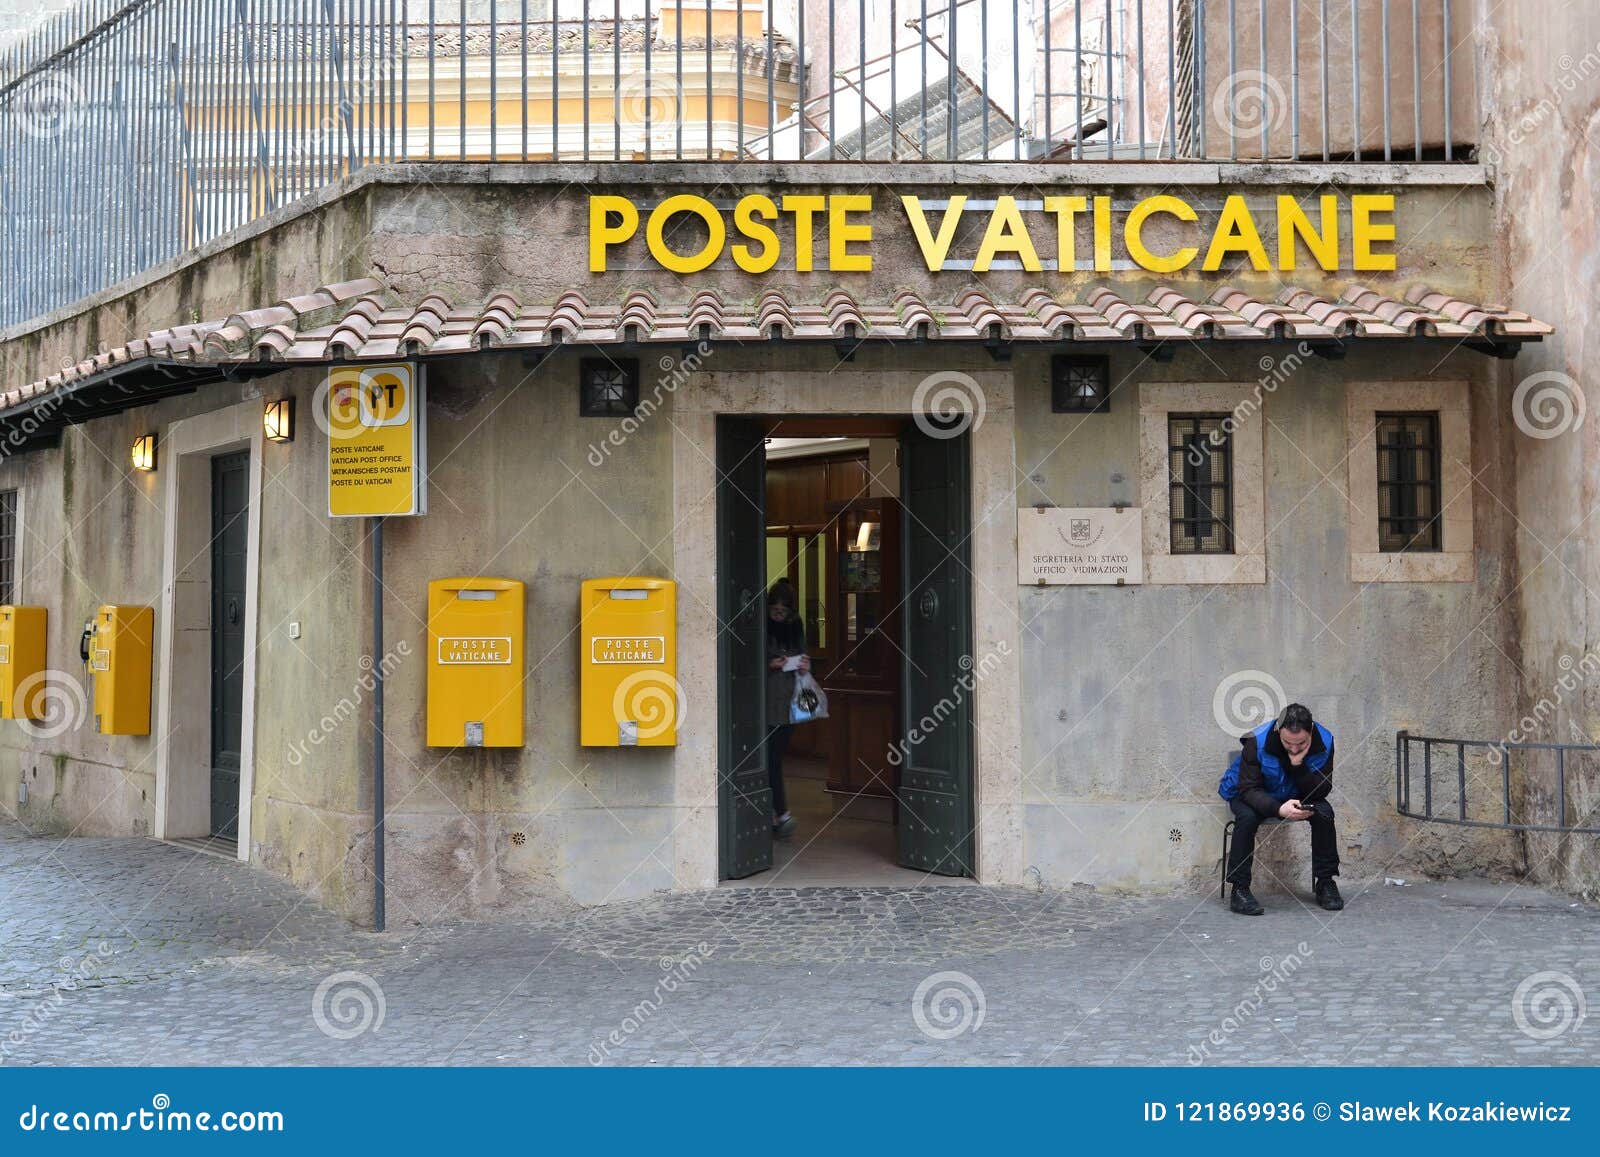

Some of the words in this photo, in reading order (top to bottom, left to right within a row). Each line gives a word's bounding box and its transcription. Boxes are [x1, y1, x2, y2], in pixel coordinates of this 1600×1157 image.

[590, 194, 872, 273] POSTE
[901, 194, 1397, 273] VATICANE
[371, 384, 398, 409] PT
[331, 446, 352, 454] POSTE
[354, 445, 384, 453] VATICANE
[331, 457, 358, 465] VATICAN
[379, 455, 402, 463] OFFICE
[331, 467, 378, 475] VATIKANISCHES
[380, 466, 411, 474] POSTAMT
[1033, 555, 1083, 563] SEGRETERIA
[1088, 555, 1097, 563] DI
[1101, 555, 1128, 563] STATO
[1033, 566, 1066, 574] UFFICIO
[1073, 566, 1128, 574] VIDIMAZIONI
[453, 640, 496, 649] POSTE
[607, 640, 649, 649] POSTE
[449, 651, 501, 661] VATICANE
[603, 651, 653, 660] VATICANE
